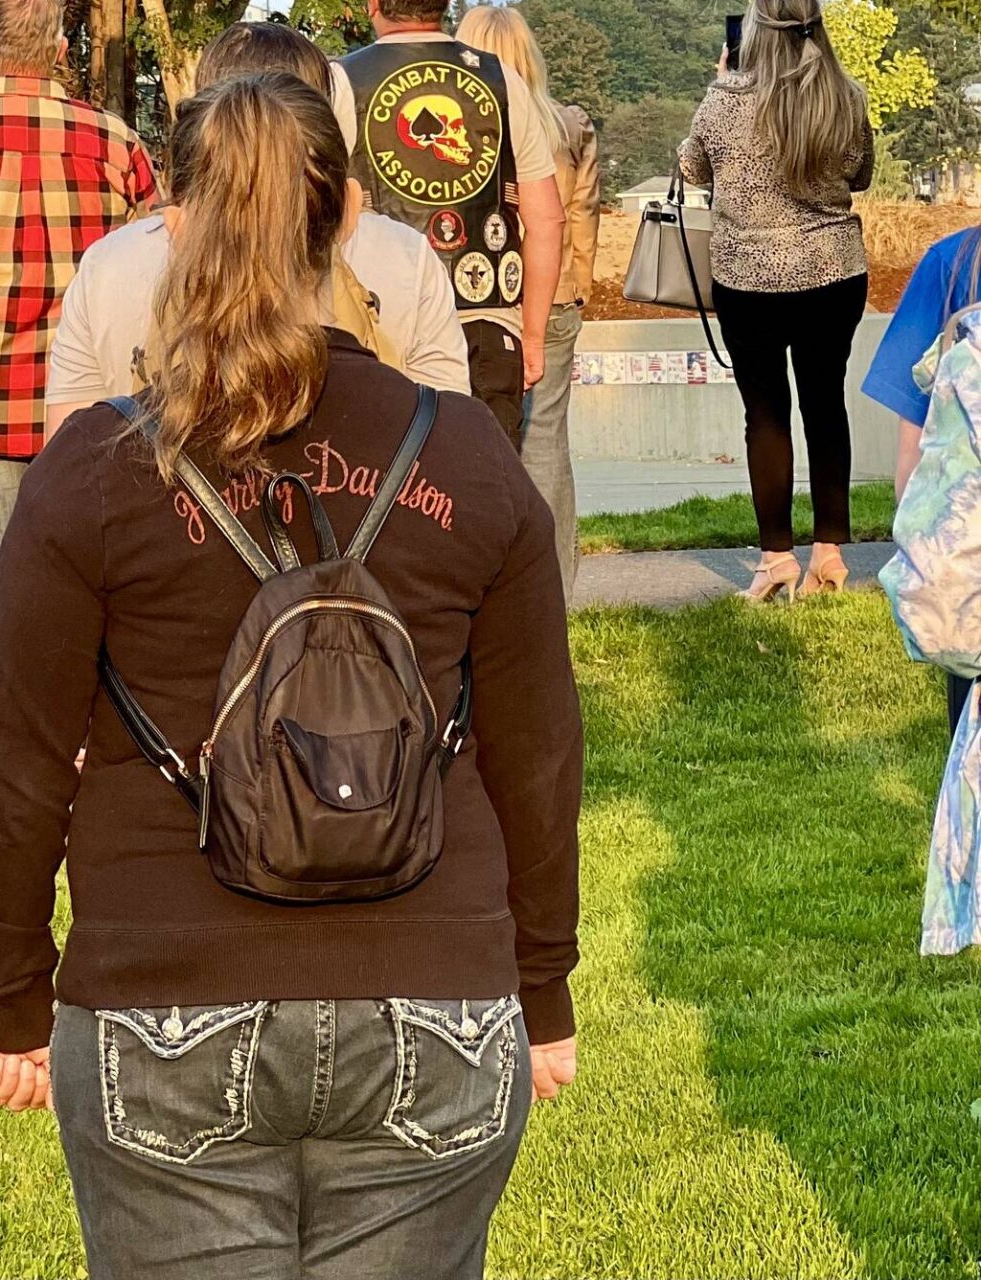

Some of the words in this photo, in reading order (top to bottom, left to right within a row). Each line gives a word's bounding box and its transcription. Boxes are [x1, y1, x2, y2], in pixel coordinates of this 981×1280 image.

[374, 66, 450, 122] COMBAT
[456, 71, 494, 116] VETS
[376, 145, 496, 199] ASSOCIATION
